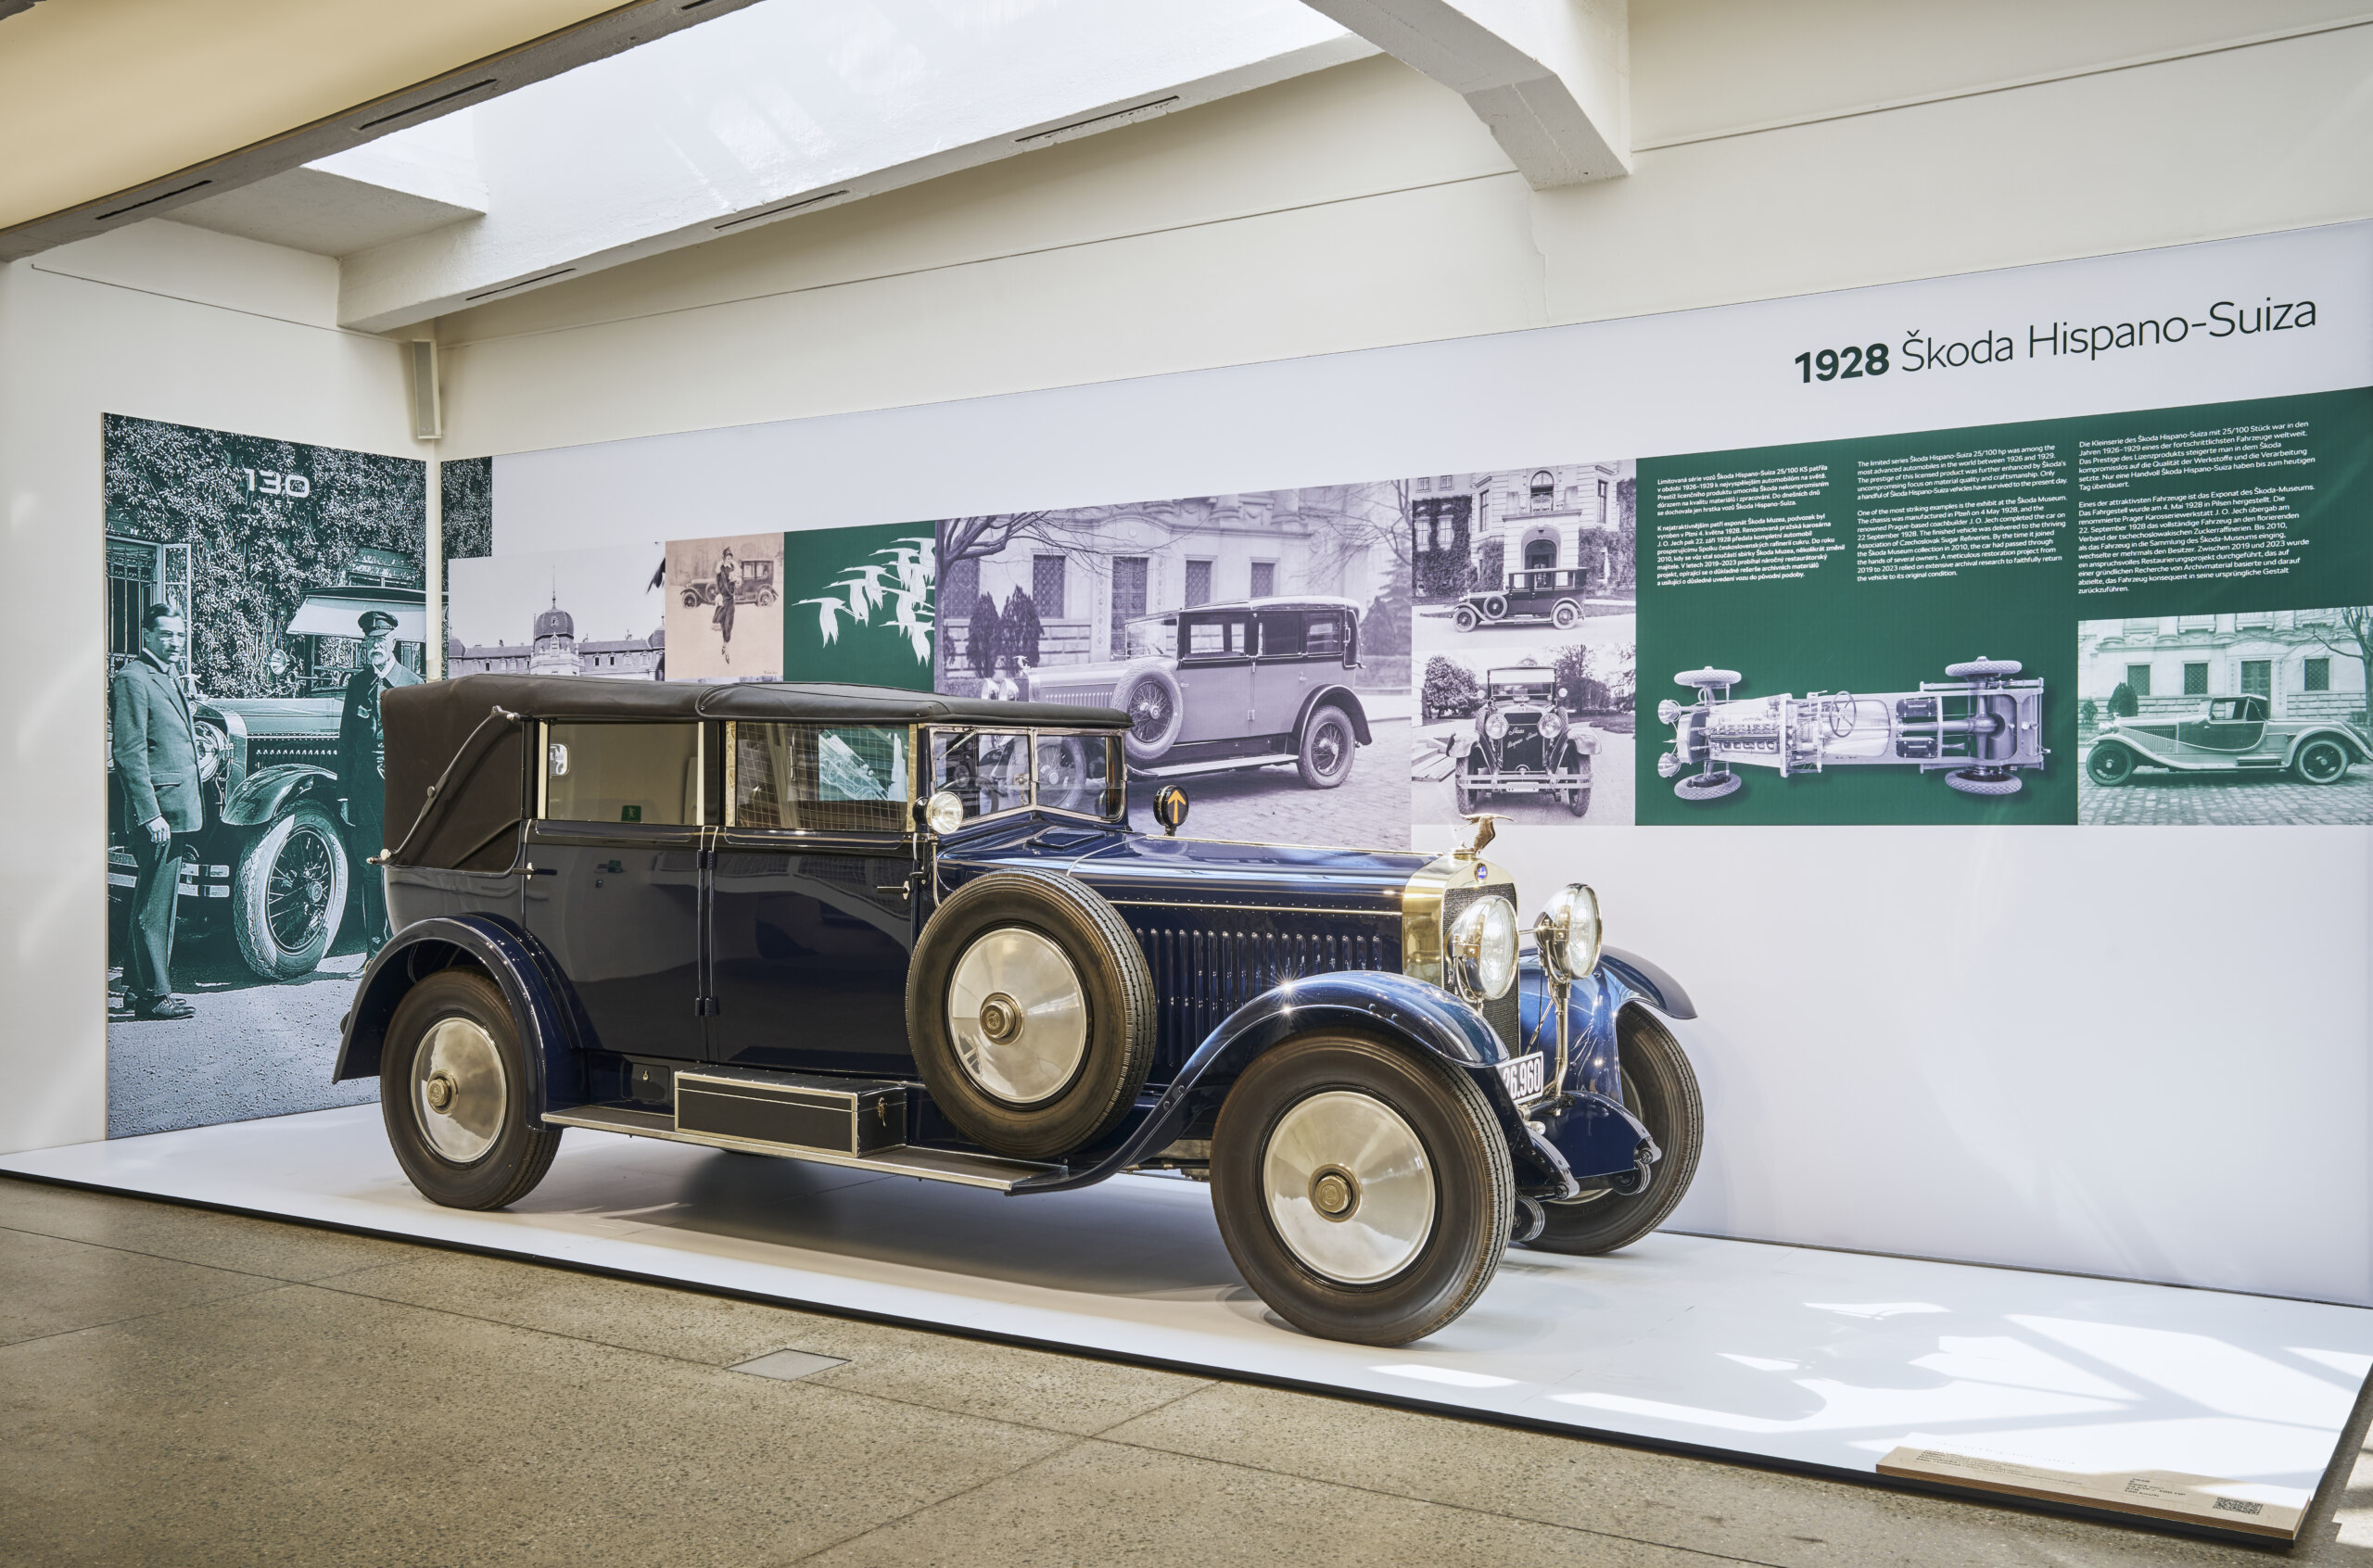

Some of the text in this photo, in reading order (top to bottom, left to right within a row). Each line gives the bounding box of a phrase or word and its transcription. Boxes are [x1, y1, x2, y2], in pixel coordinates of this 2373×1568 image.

[1795, 297, 2317, 384] 1928 Škoda Hispano-Suiza
[2091, 437, 2123, 447] Kleinserie
[2159, 430, 2207, 441] Hispano-Suiza
[2222, 425, 2249, 435] 25/100
[2250, 424, 2270, 432] Stück
[2173, 436, 2235, 448] fortschrittlichsten
[1870, 458, 1890, 466] limited
[1910, 454, 1928, 462] Škoda
[1929, 451, 1972, 462] Hispano-Suiza
[1973, 449, 1997, 457] 25/100
[2078, 463, 2128, 474] kompromisslos
[2151, 459, 2179, 467] Qualität
[2193, 454, 2232, 463] Werkstoffe
[2260, 449, 2307, 458] Verarbeitung
[2092, 456, 2120, 464] Prestige
[2134, 449, 2184, 461] Lizenzprodukts
[2186, 447, 2216, 456] steigerte
[2259, 441, 2281, 449] Škoda
[1870, 474, 1894, 484] prestige
[1914, 470, 1938, 478] licensed
[1939, 468, 1963, 478] product
[2001, 462, 2032, 472] enhanced
[1873, 465, 1901, 474] advanced
[1902, 462, 1939, 471] automobiles
[2130, 469, 2160, 477] Handvoll
[2161, 467, 2182, 475] Škoda
[2183, 463, 2231, 474] Hispano-Suiza
[2283, 457, 2315, 465] heutigen
[243, 467, 311, 499] 130
[1857, 482, 1906, 492] uncompromising
[1934, 477, 1958, 486] material
[1959, 475, 1979, 485] quality
[1861, 491, 1882, 499] handful
[1908, 487, 1948, 497] Hispano-Suiza
[1987, 481, 2012, 489] survived
[2031, 477, 2054, 487] present
[2078, 484, 2090, 492] Tag
[2109, 497, 2151, 505] attraktivsten
[2210, 489, 2239, 499] Exponat
